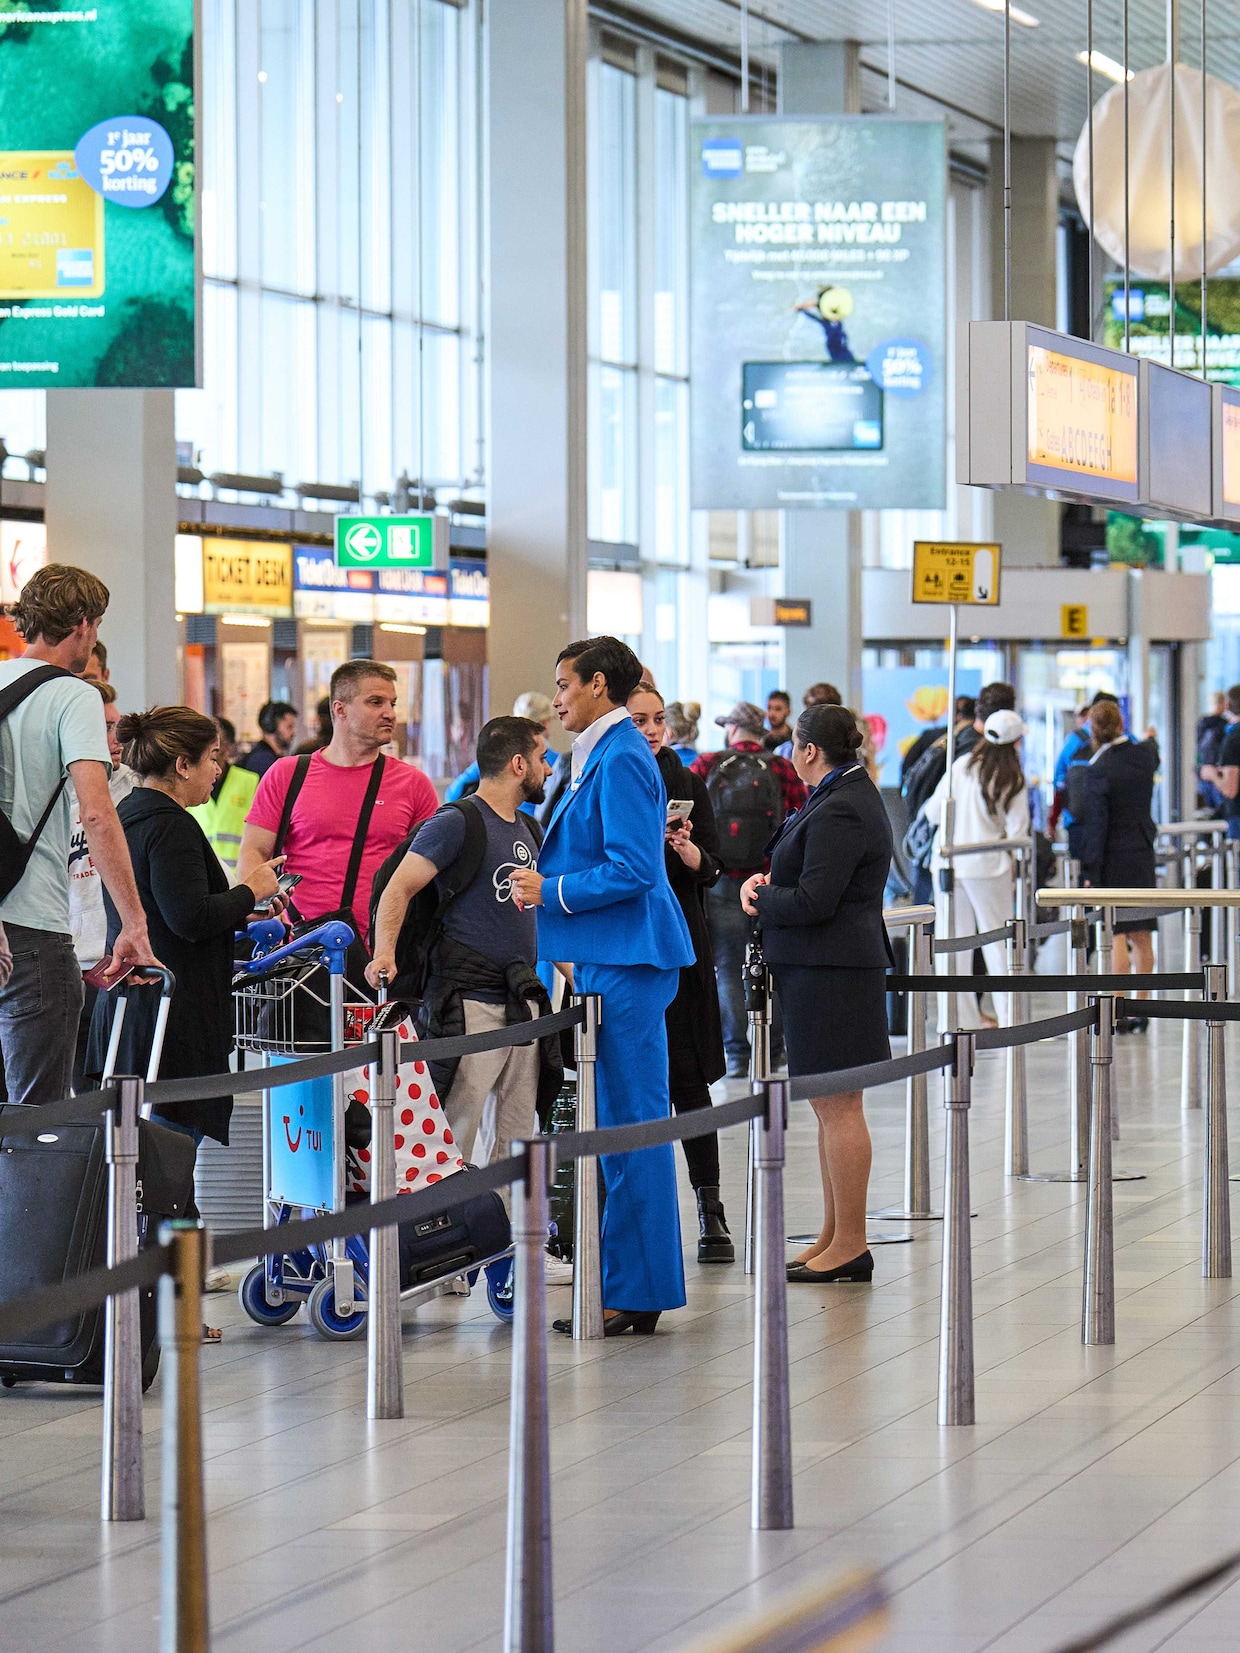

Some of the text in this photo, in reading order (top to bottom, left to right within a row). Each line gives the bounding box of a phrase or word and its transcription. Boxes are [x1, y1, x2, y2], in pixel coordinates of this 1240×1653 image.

[122, 129, 152, 148] jaar
[100, 148, 159, 175] 50%
[102, 175, 157, 195] korting
[712, 201, 927, 223] SNELLER NAAR EEN
[735, 223, 901, 243] HOGER NIVEAU
[12, 305, 52, 320] Express
[53, 304, 78, 318] Gold
[79, 304, 105, 318] Card
[930, 547, 970, 556] Entrance
[208, 556, 289, 586] TICKET DESK
[946, 558, 970, 566] 12-15
[1068, 608, 1081, 633] E
[306, 1129, 322, 1151] TUI
